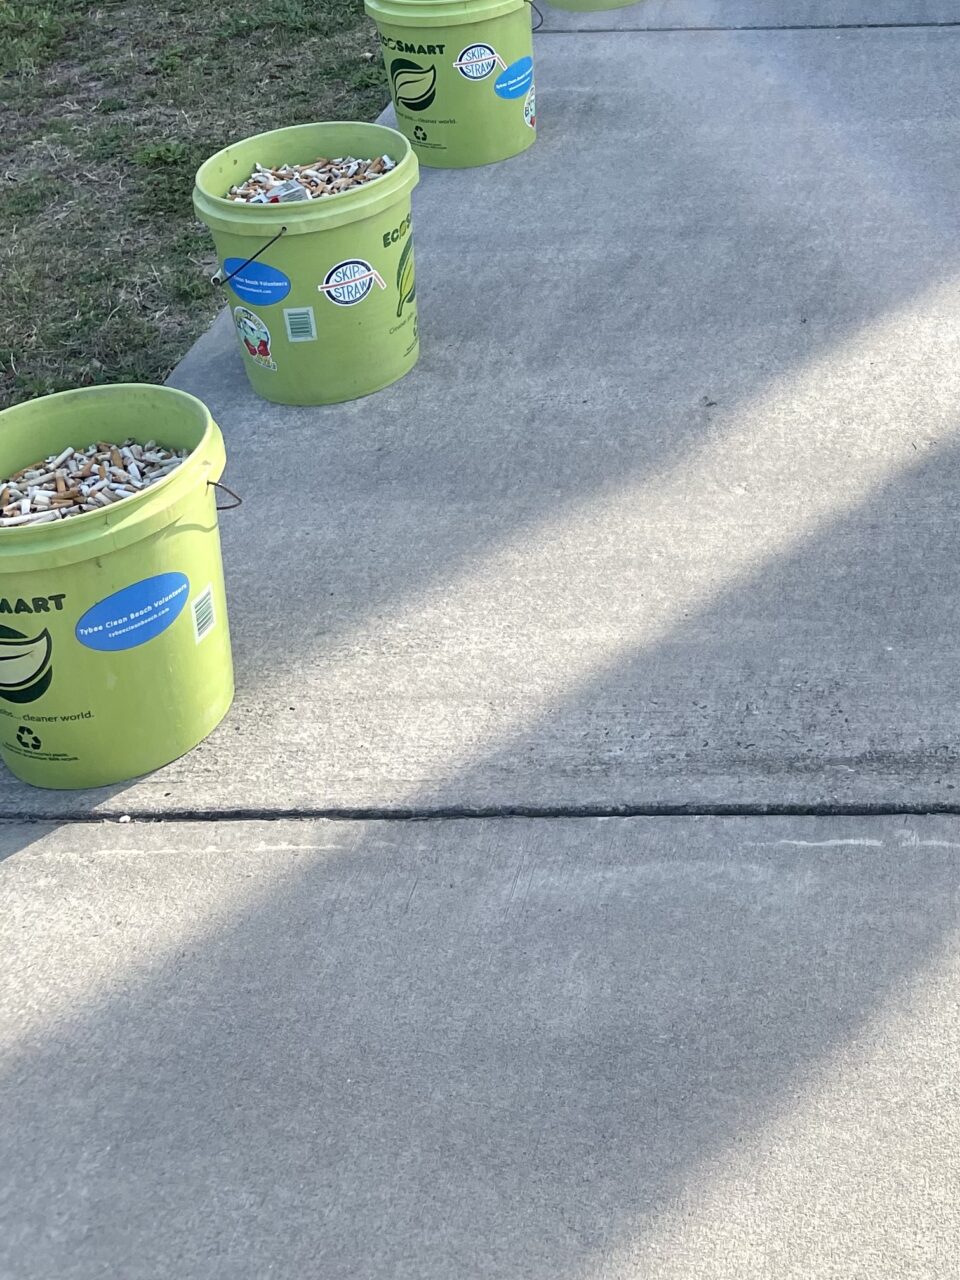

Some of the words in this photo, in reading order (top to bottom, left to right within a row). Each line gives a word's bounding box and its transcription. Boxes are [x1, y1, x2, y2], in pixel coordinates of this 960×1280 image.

[465, 47, 486, 61] SKIP
[465, 61, 492, 77] STRAW
[334, 265, 360, 283] SKIP
[334, 279, 368, 300] STRAW
[80, 625, 103, 636] Tybee
[105, 617, 128, 628] Clean
[130, 606, 152, 620] Beach
[153, 583, 187, 608] Volunteers
[22, 714, 58, 722] cleaner
[60, 710, 95, 722] world.
